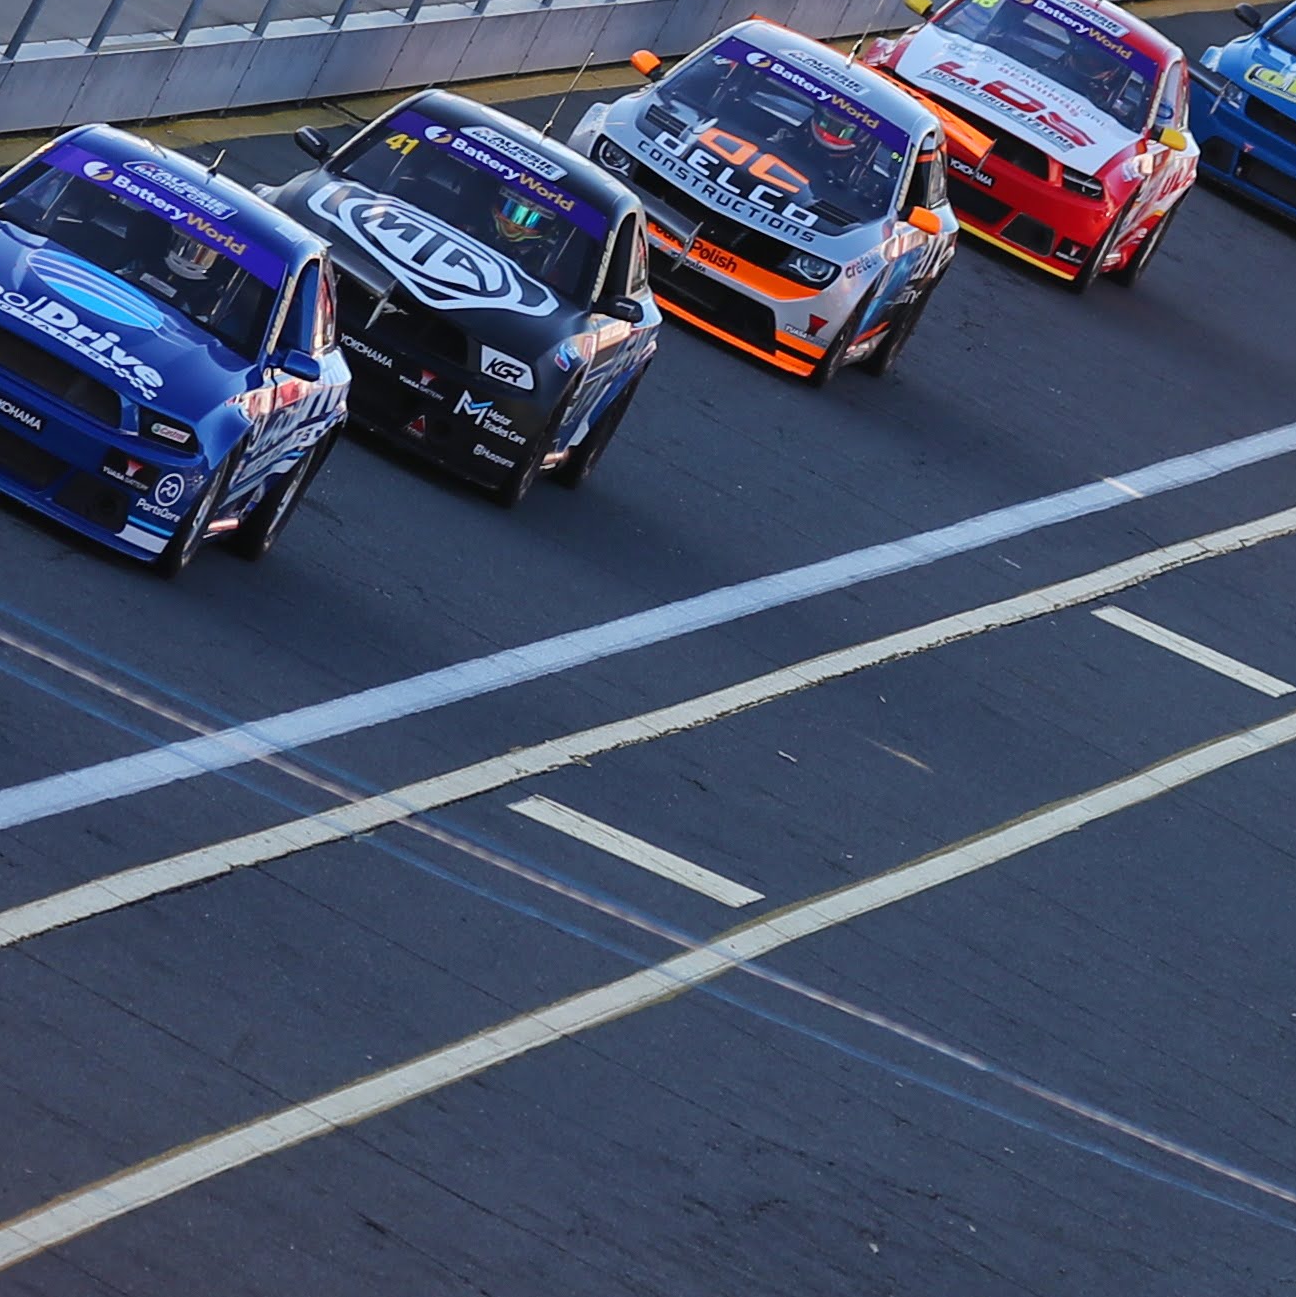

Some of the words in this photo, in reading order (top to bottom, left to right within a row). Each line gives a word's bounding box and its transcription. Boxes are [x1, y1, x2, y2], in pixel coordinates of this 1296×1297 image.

[384, 133, 419, 155] 41
[654, 130, 820, 228] DELCO
[949, 158, 994, 187] YOKOHAMA
[340, 332, 393, 369] YOKOHAMA
